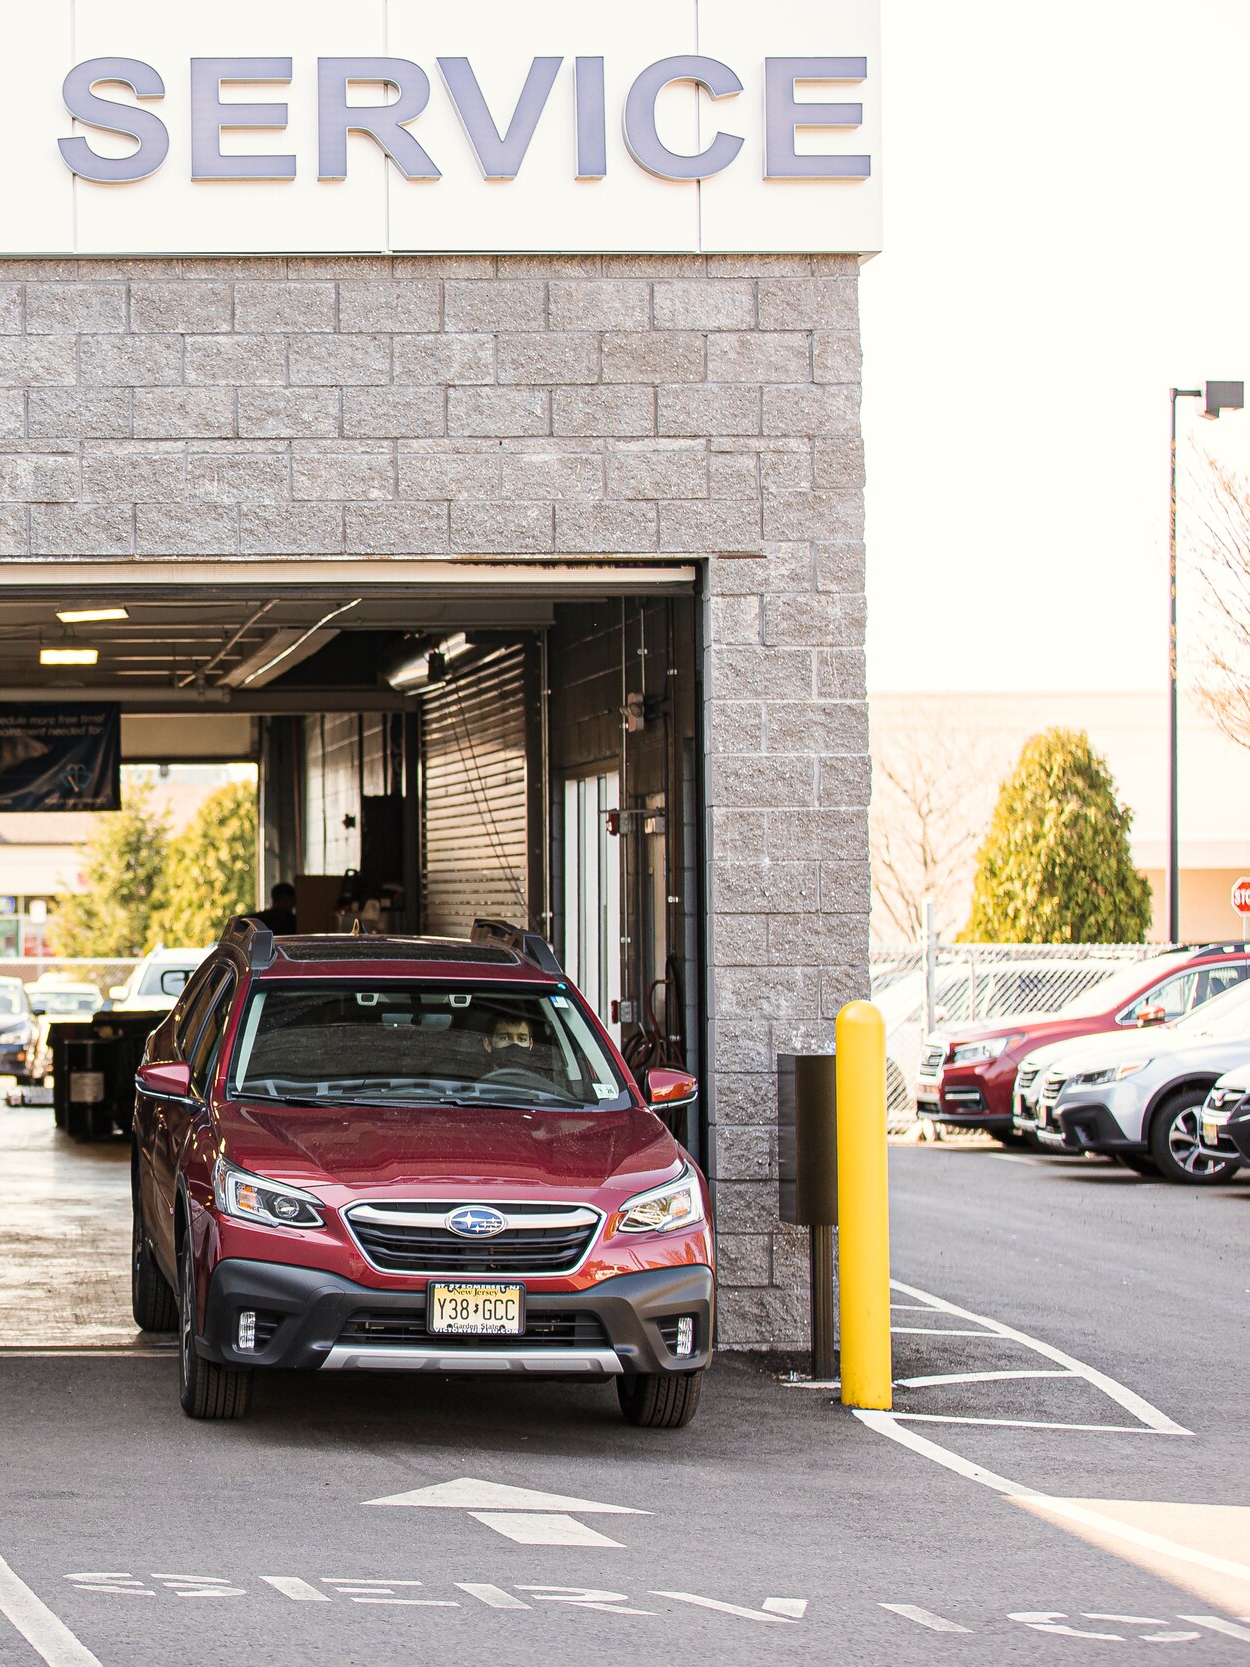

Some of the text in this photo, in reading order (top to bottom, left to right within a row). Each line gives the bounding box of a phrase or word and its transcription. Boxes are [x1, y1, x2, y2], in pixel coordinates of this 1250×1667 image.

[57, 55, 871, 184] SERVICE
[1234, 888, 1250, 906] STO
[473, 1288, 498, 1297] Jersey
[437, 1298, 515, 1320] Y38 GCC
